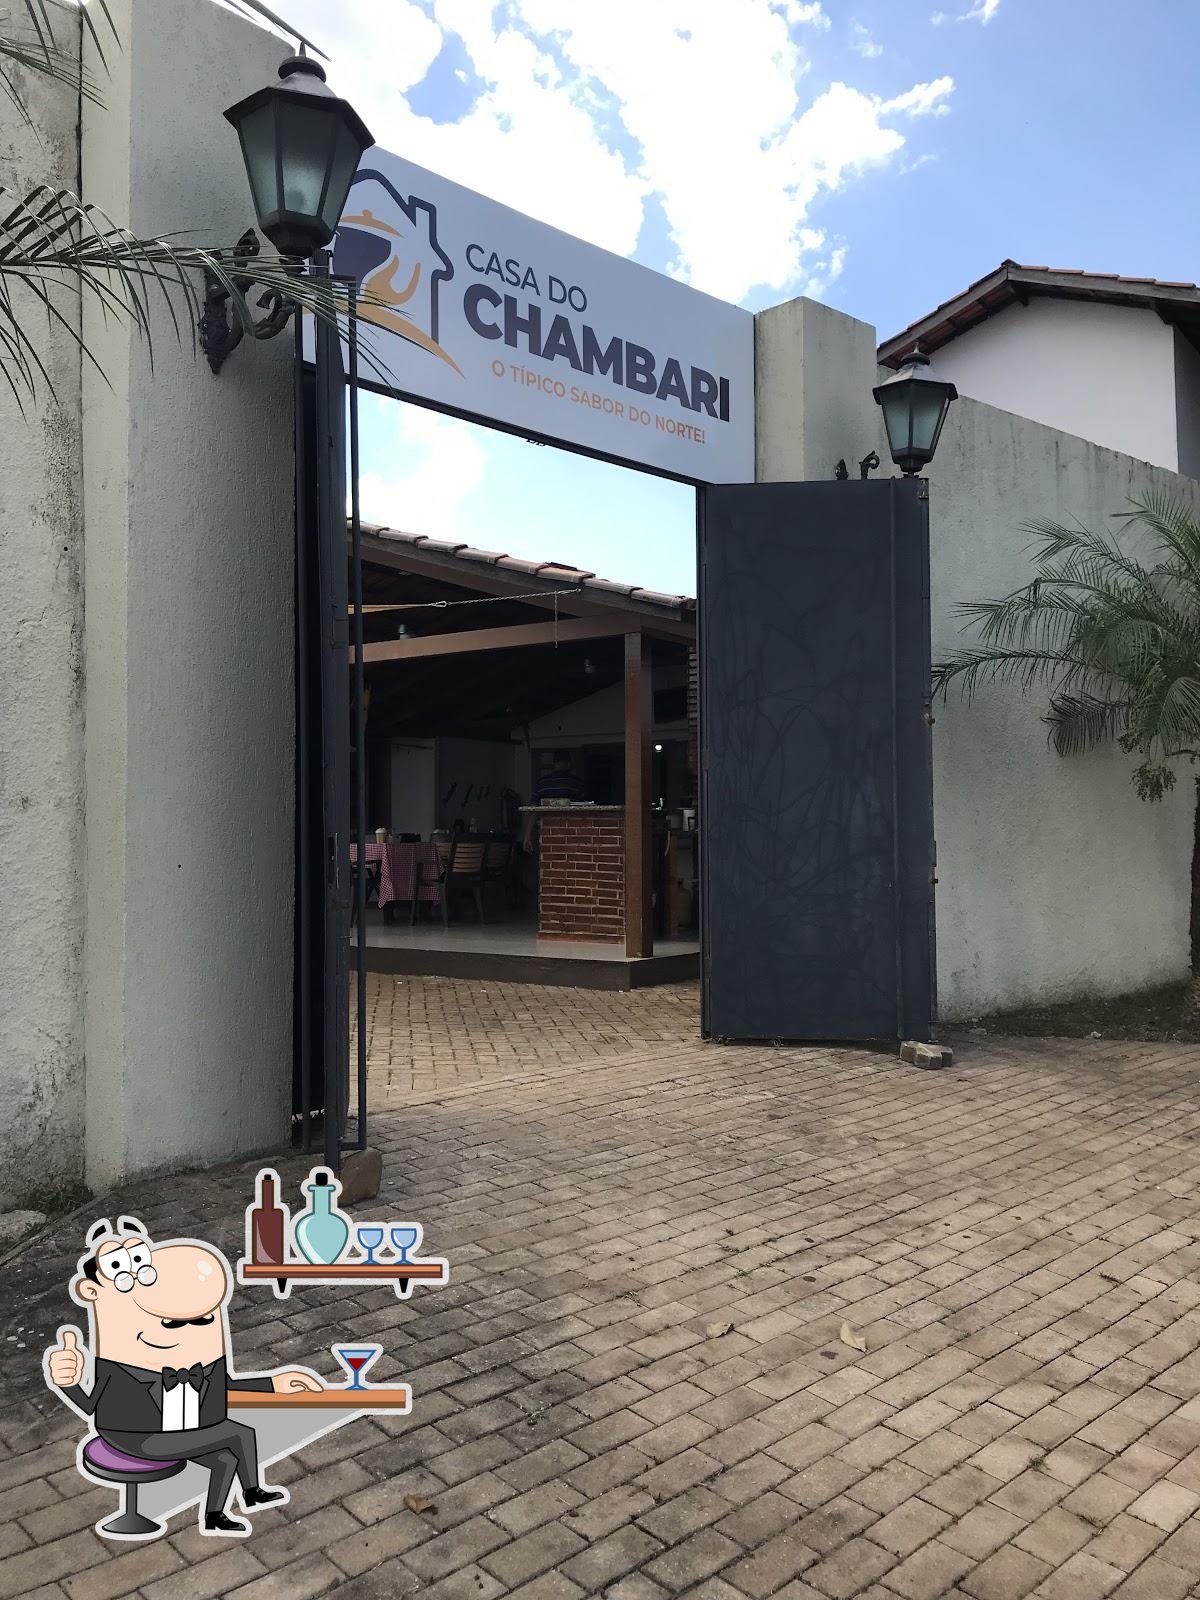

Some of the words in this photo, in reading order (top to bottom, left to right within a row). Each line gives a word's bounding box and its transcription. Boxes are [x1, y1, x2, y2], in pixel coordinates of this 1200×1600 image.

[465, 243, 541, 296] CASA
[548, 275, 588, 313] DO
[463, 283, 730, 423] CHAMBARI
[491, 359, 505, 378] O
[510, 363, 566, 398] TÍPICO
[570, 387, 624, 417] SABOR
[629, 406, 651, 425] DO
[655, 416, 705, 444] NORTE!
